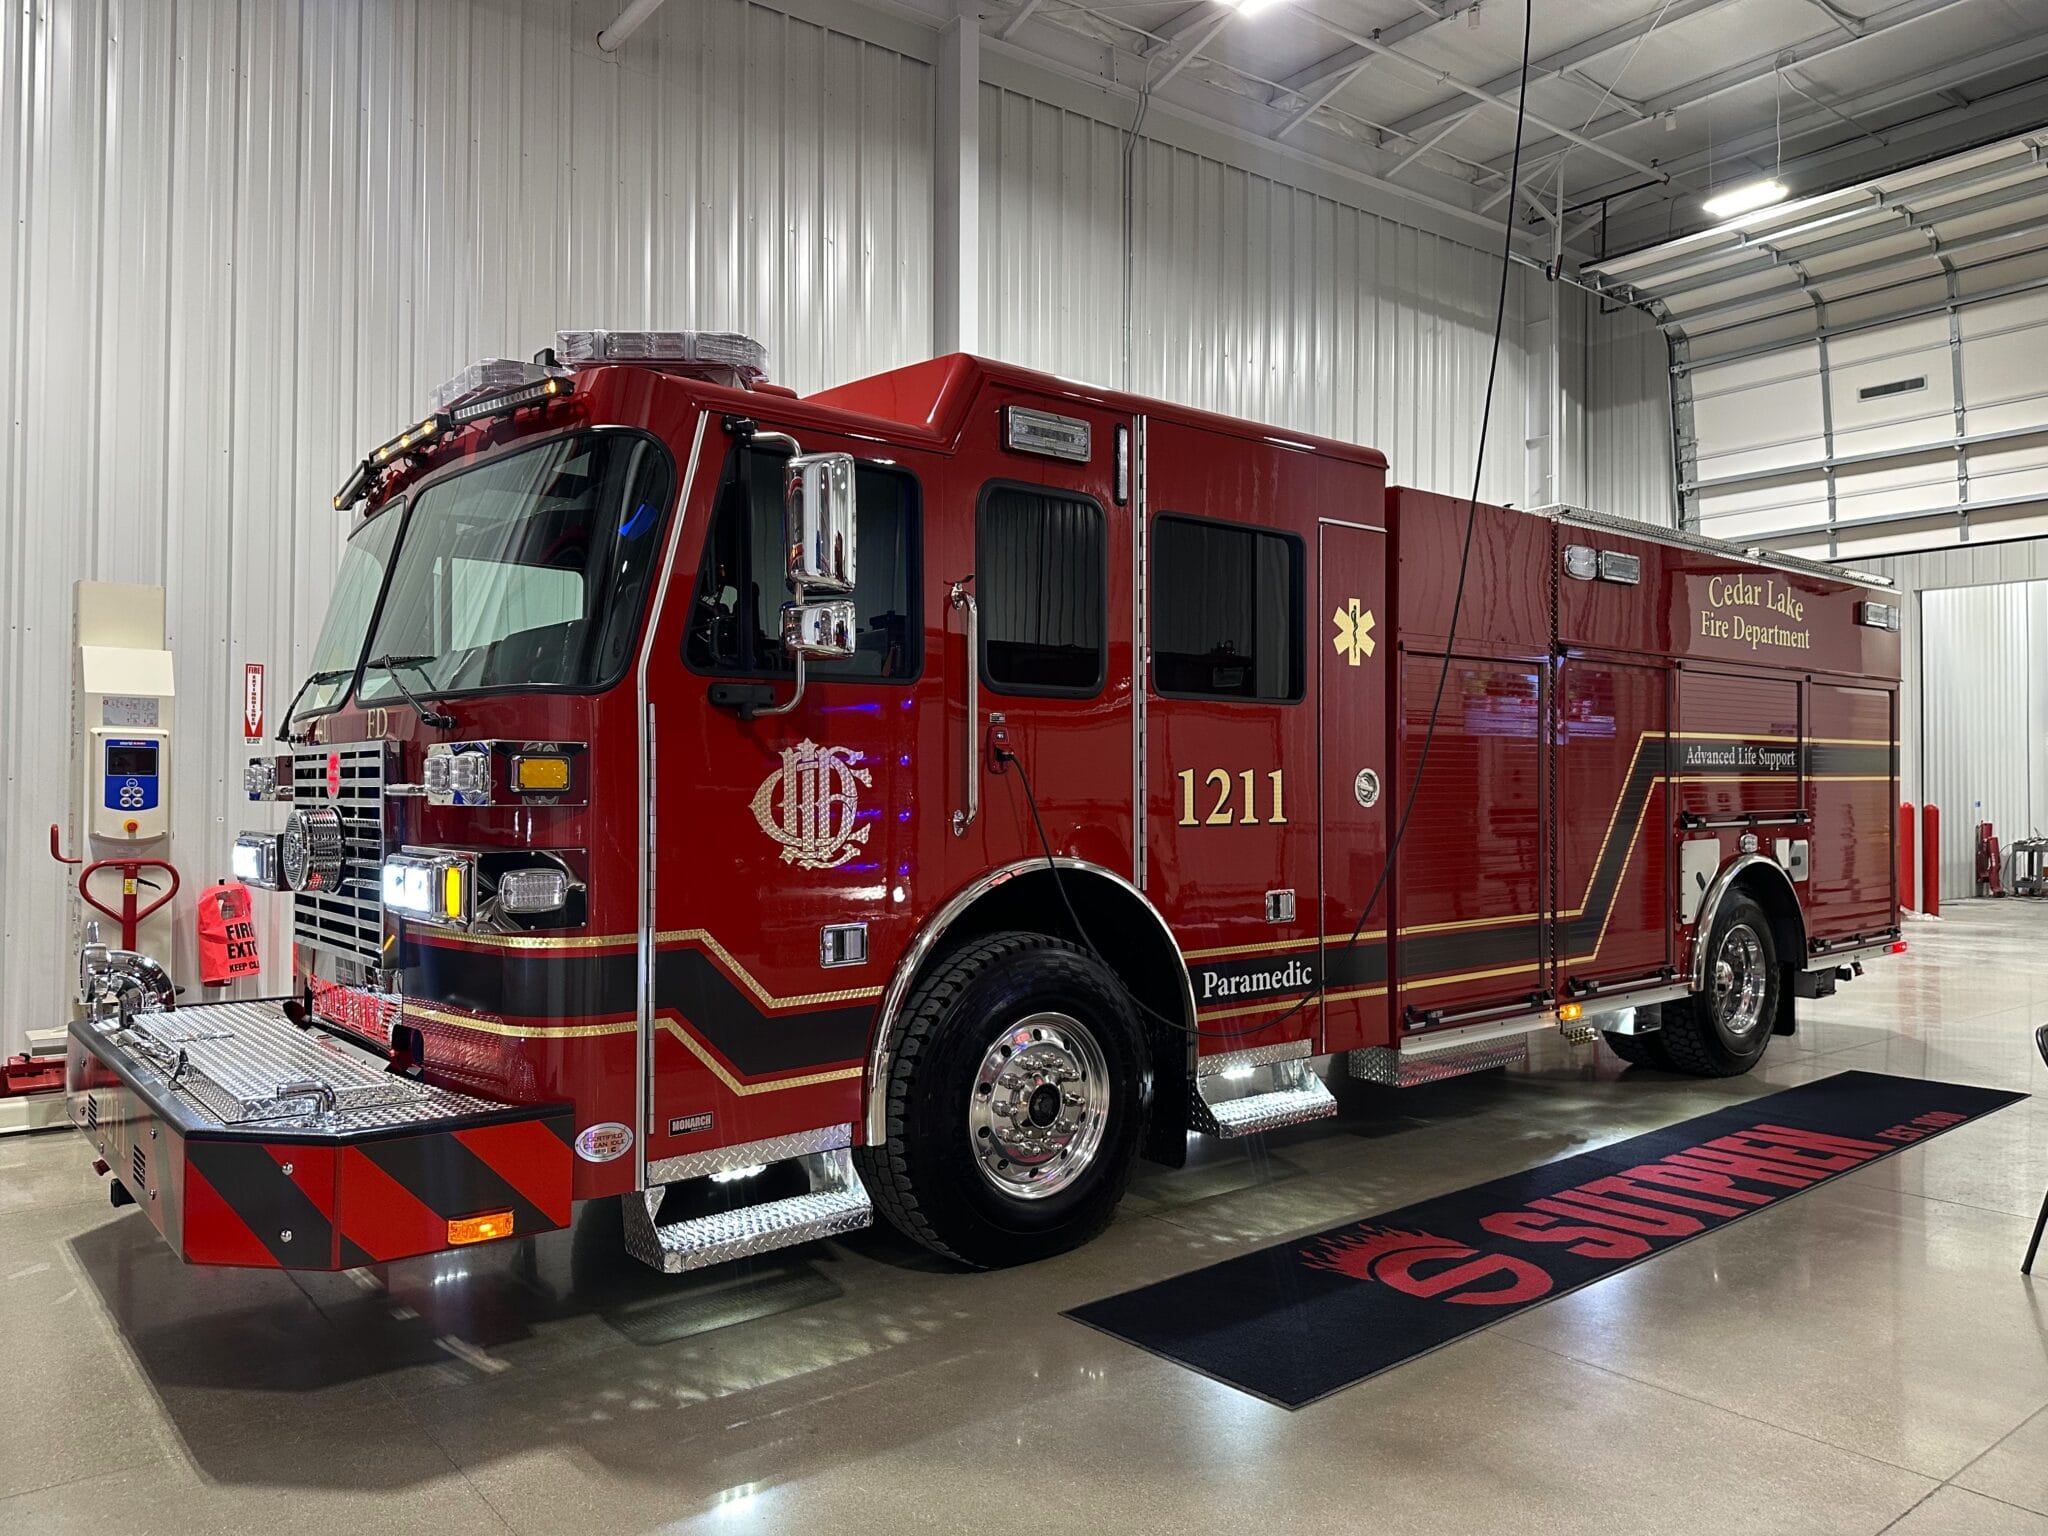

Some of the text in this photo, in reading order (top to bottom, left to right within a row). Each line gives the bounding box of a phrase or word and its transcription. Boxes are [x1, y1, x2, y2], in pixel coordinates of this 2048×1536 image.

[1708, 573, 1804, 622] Cedar Lake
[1701, 610, 1810, 650] Fire Department
[248, 666, 261, 675] FIRE
[366, 707, 388, 739] FD
[1686, 745, 1796, 771] Advanced Life Support
[1177, 768, 1288, 826] 1211
[229, 962, 248, 973] KEEP
[1203, 960, 1312, 998] Paramedic
[587, 1132, 623, 1143] CERTIFIED
[672, 1114, 712, 1132] MONARCH
[583, 1138, 624, 1150] CLEAN IDLE
[1478, 1123, 1898, 1259] SUTPHEN
